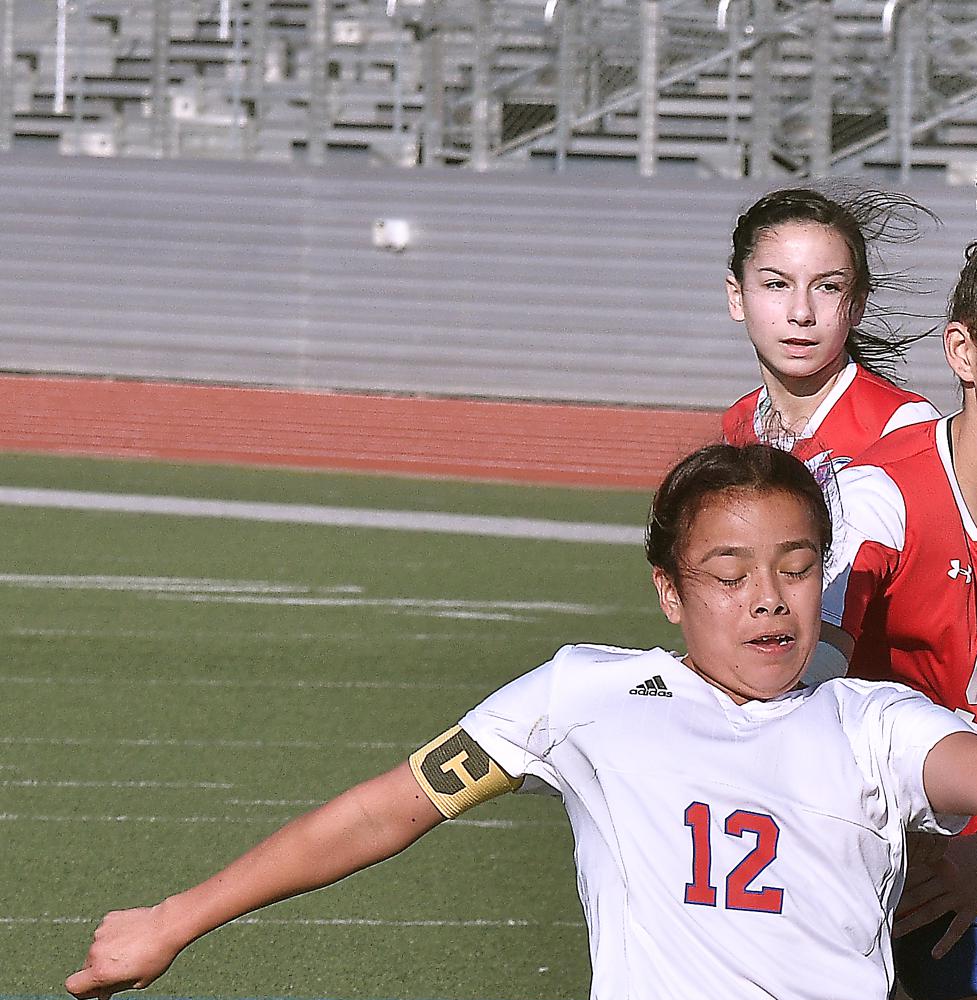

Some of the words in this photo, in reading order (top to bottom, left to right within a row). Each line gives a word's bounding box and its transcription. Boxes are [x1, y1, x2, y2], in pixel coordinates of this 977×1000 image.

[629, 684, 673, 698] adidas
[421, 729, 490, 795] C
[684, 801, 784, 914] 12
